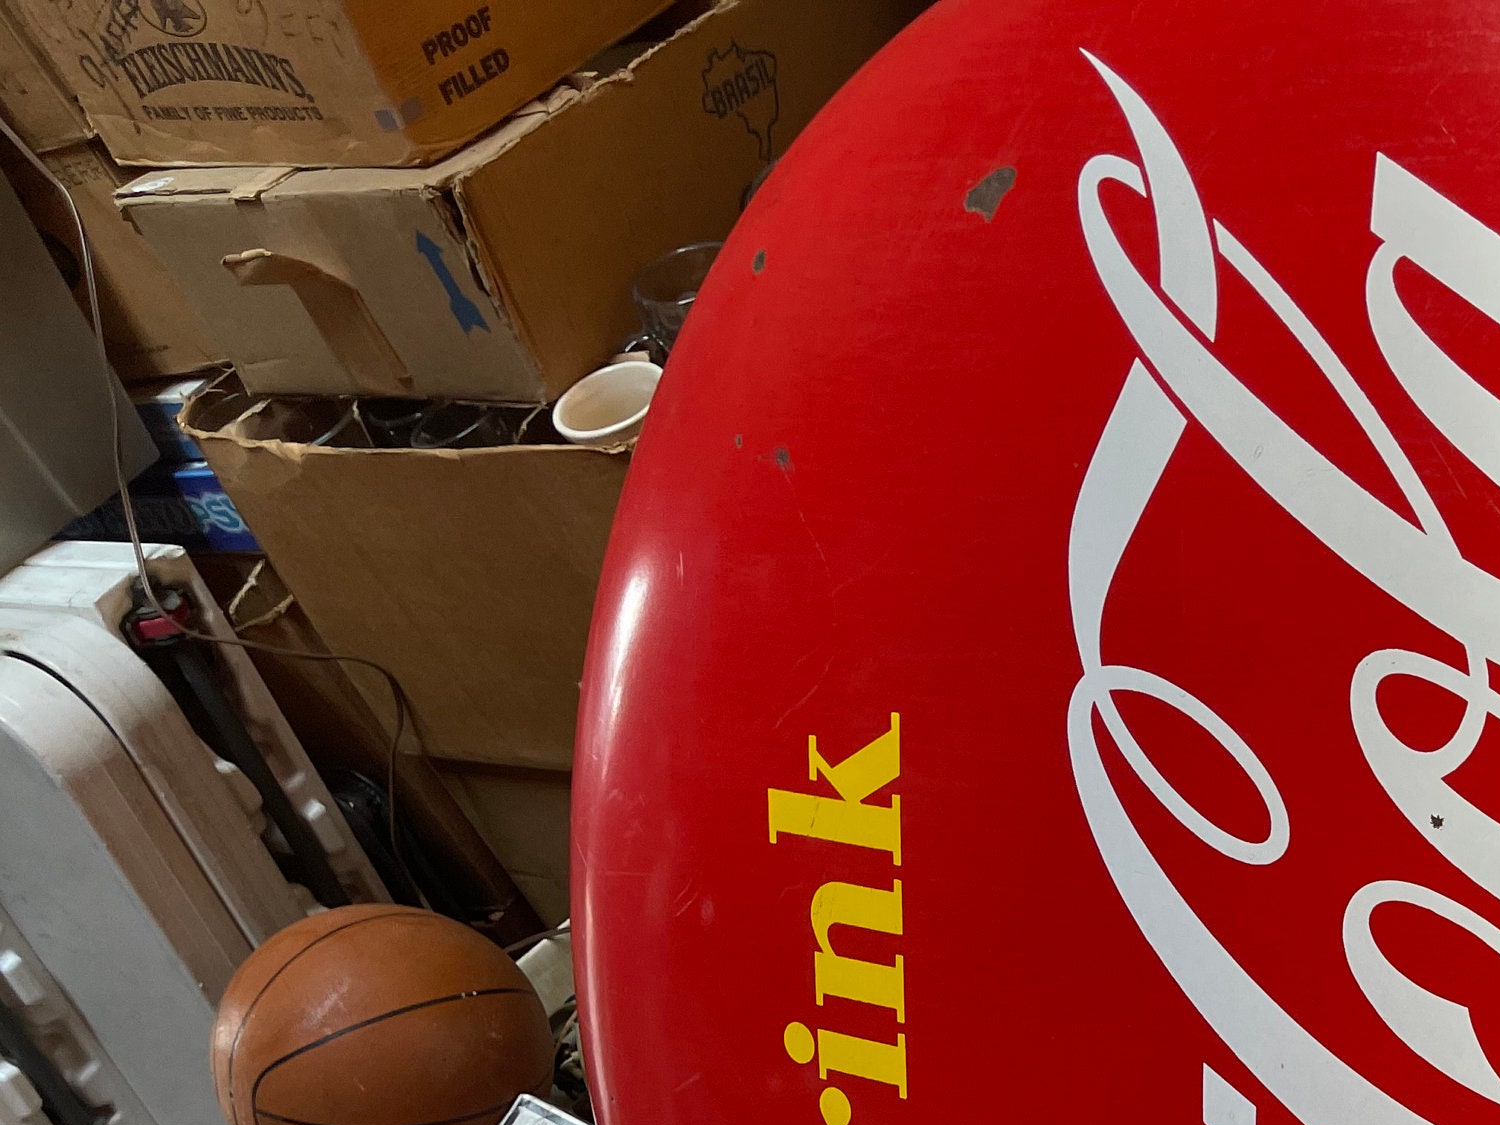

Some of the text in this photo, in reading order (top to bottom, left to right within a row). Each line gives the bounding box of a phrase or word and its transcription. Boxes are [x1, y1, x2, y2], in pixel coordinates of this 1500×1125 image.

[420, 6, 493, 66] PROOF
[438, 47, 511, 106] FILLED
[711, 57, 775, 113] BRASIL
[142, 105, 324, 121] FAMILY OF FINE PRODUCTS
